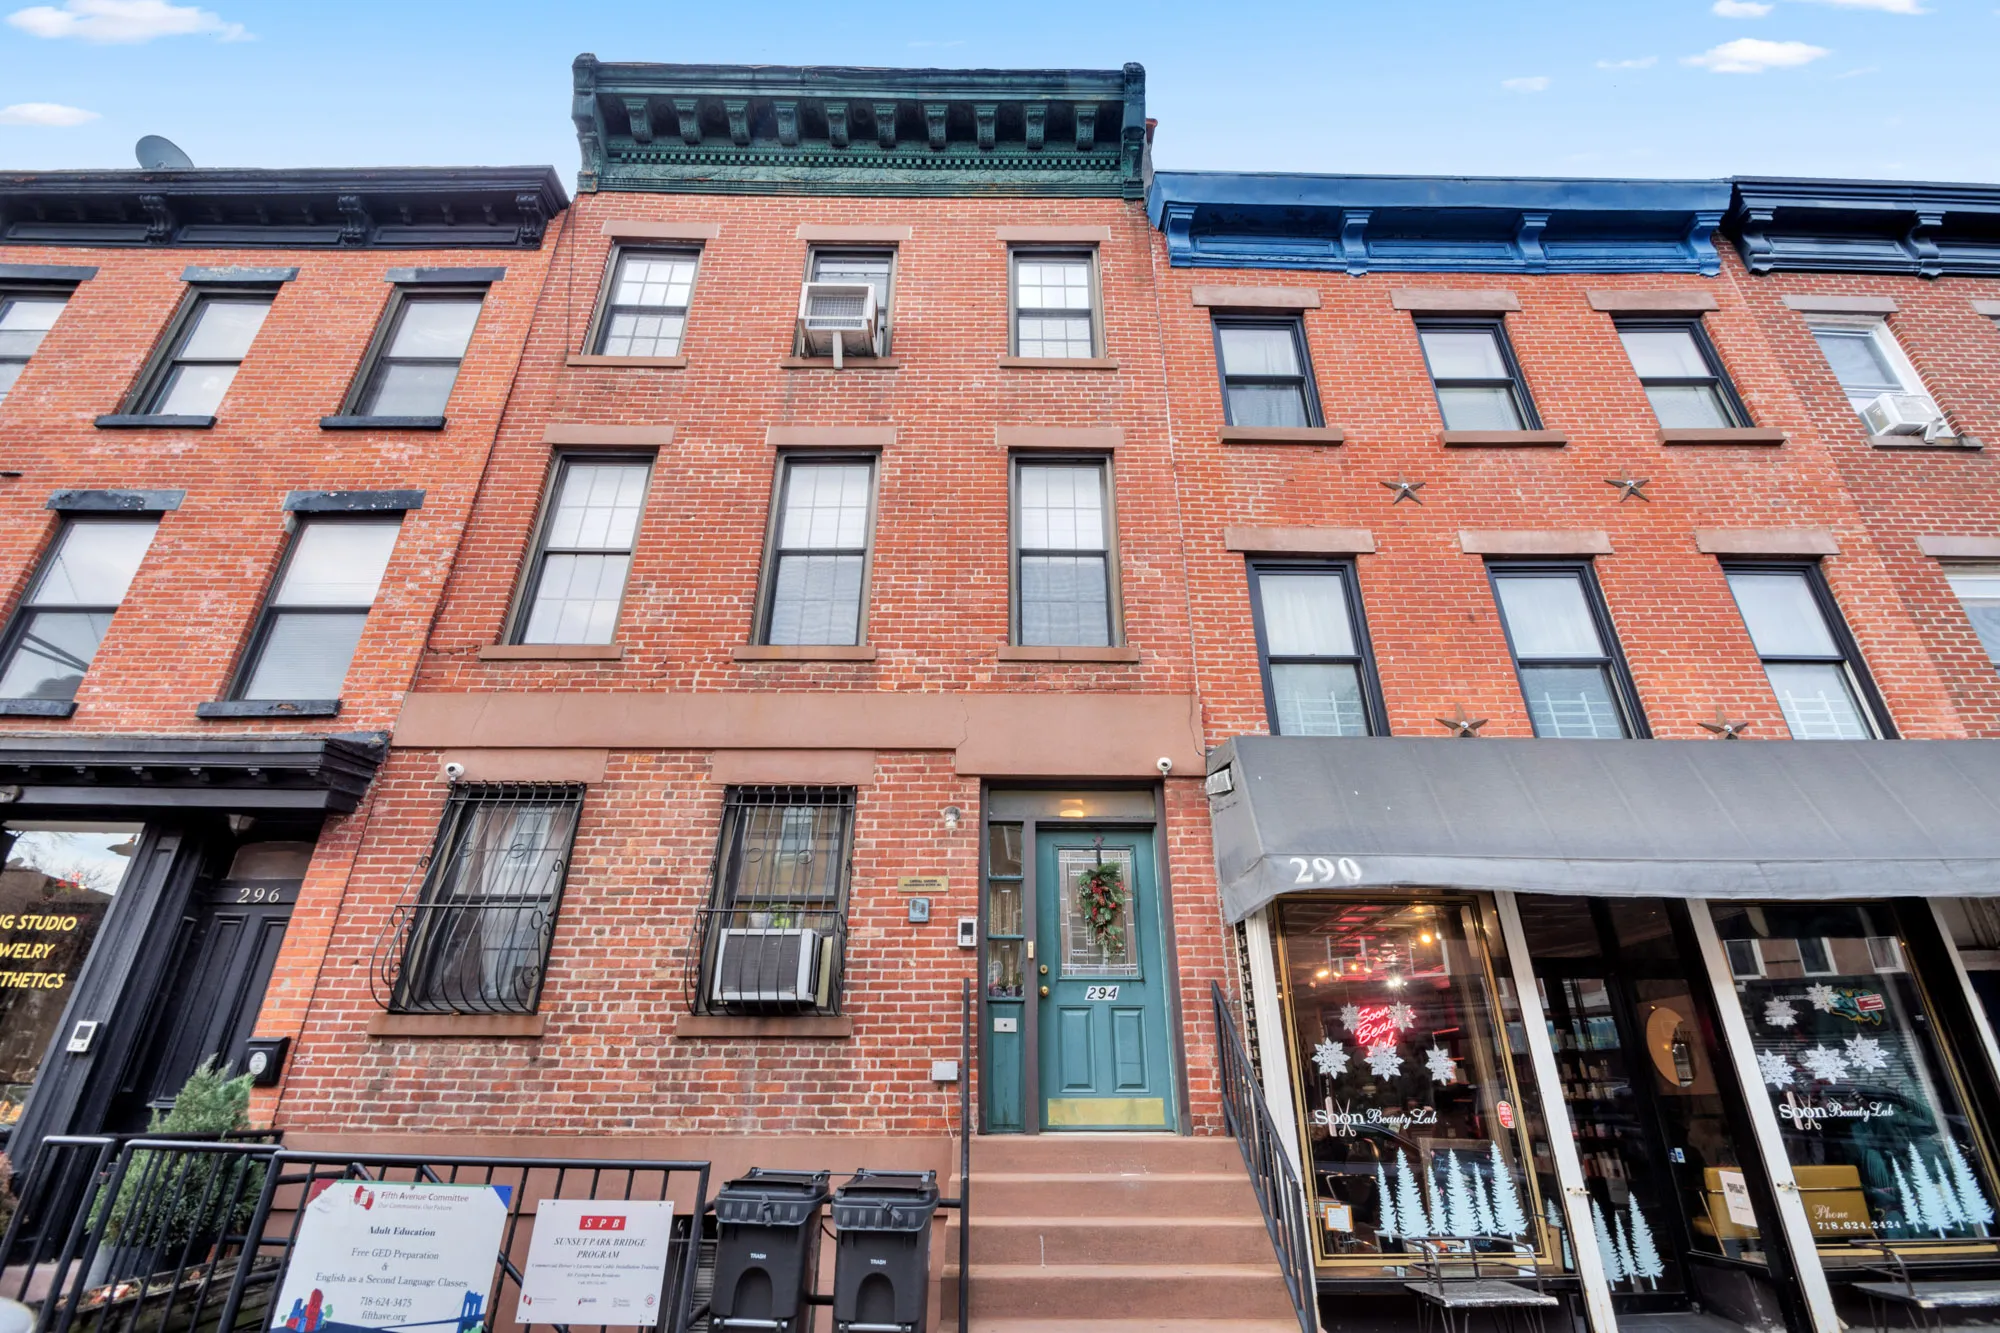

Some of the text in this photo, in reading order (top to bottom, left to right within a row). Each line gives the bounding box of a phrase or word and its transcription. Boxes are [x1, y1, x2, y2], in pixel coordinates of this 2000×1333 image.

[1289, 857, 1362, 884] 290
[236, 887, 281, 904] 296
[17, 915, 78, 931] STUDIO
[0, 971, 66, 989] THETICS
[1086, 986, 1118, 1000] 294
[1357, 1006, 1390, 1026] Soon
[1314, 1108, 1438, 1129] Soon Beauty Lab
[1778, 1101, 1894, 1122] Soon Beauty Lab
[381, 1191, 469, 1202] Fifth Avenue Committee
[1812, 1204, 1848, 1220] Phone
[369, 1225, 436, 1237] Adult Education
[1817, 1221, 1901, 1230] 718.624.2424
[553, 1237, 647, 1247] SUNSET PARK BRIDGE
[351, 1247, 440, 1260] Free GED Preparation
[577, 1250, 620, 1259] PROGRAM
[381, 1262, 389, 1271] &
[315, 1272, 346, 1283] English
[366, 1274, 396, 1285] Second
[397, 1276, 436, 1287] Language
[437, 1277, 468, 1288] Classes
[360, 1296, 412, 1308] 718-624-3475
[361, 1310, 408, 1323] fifthave.org
